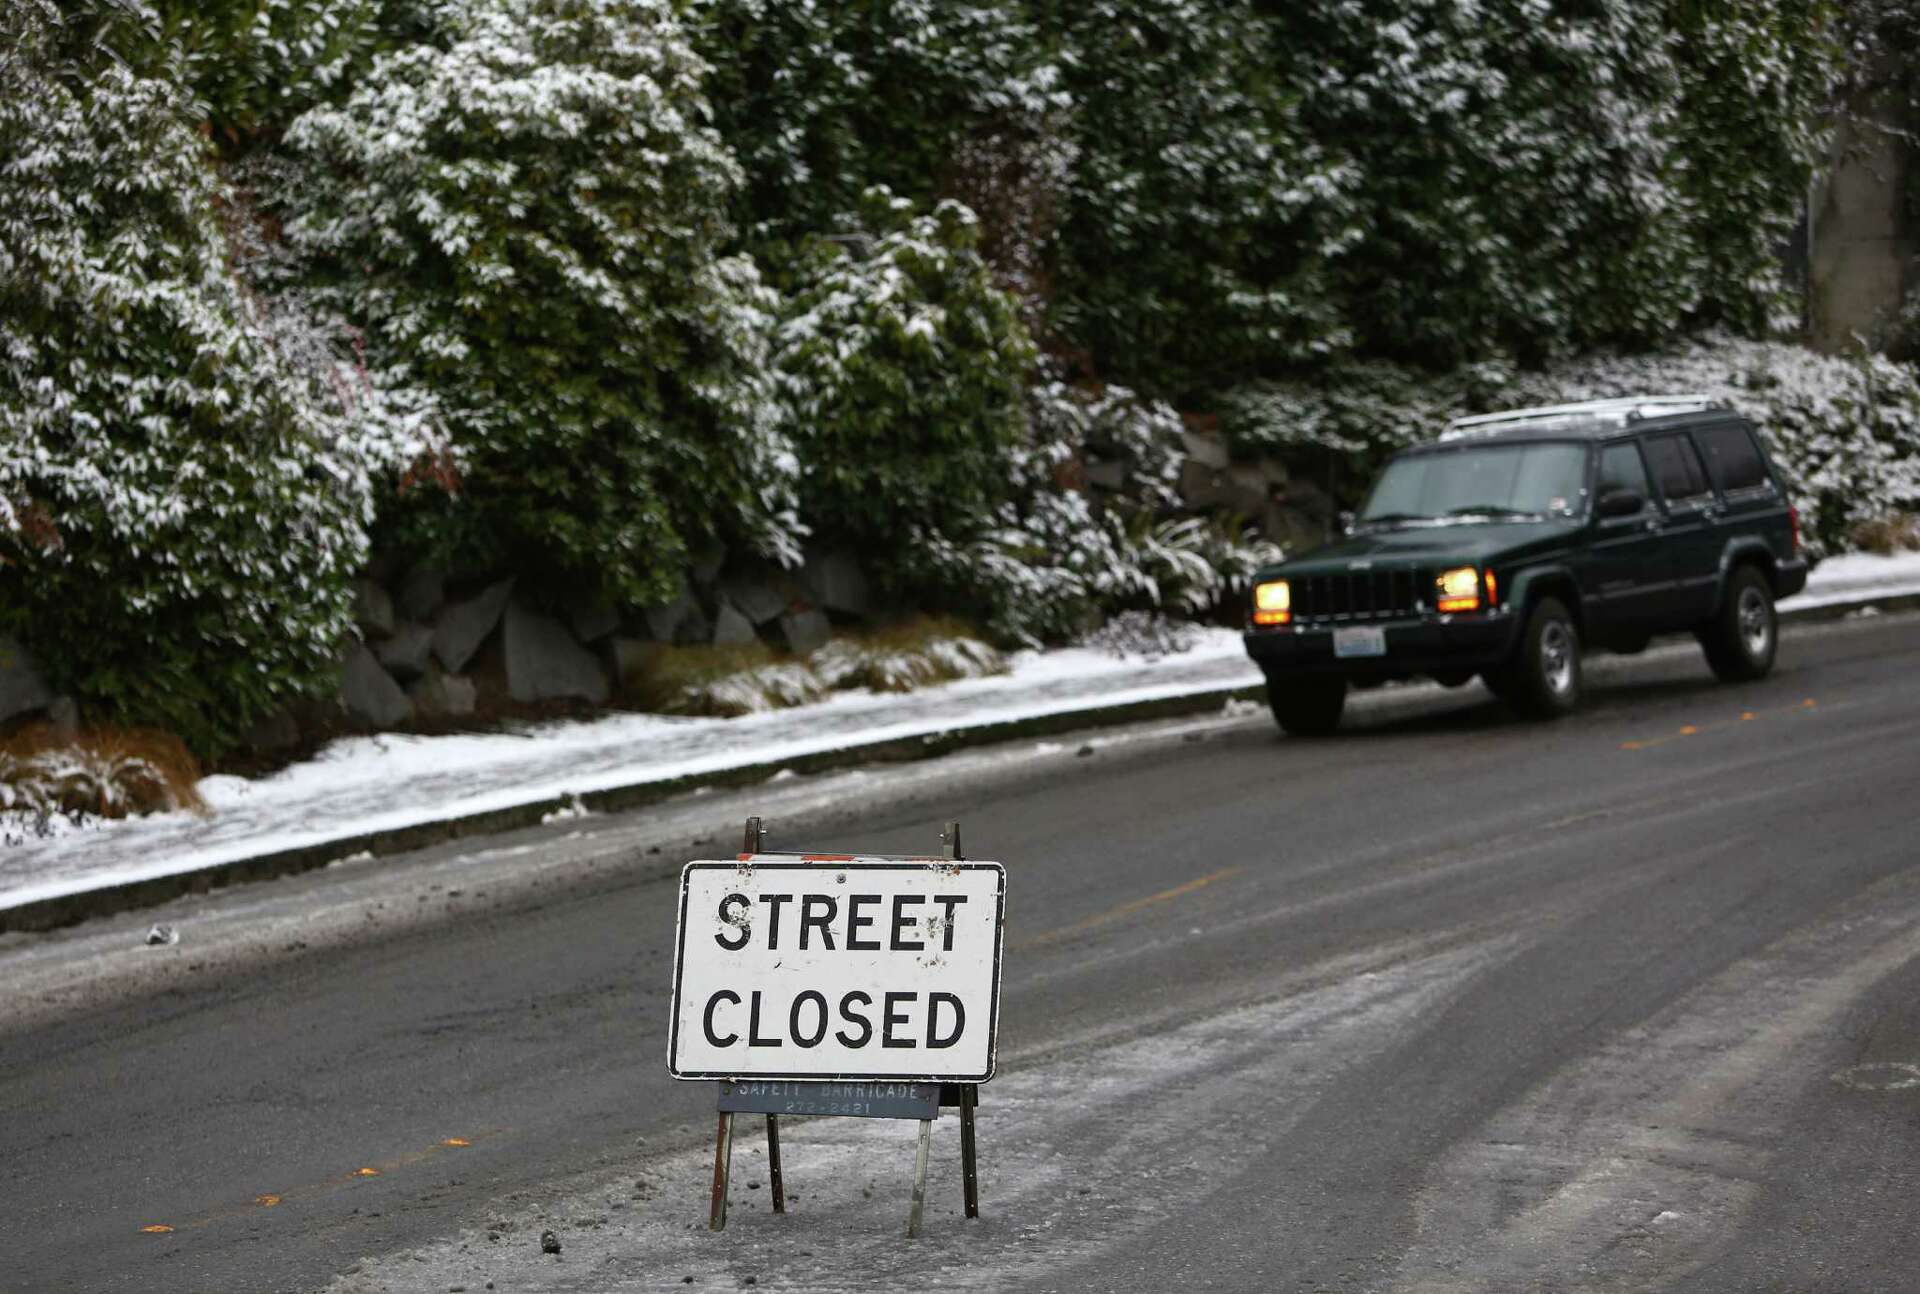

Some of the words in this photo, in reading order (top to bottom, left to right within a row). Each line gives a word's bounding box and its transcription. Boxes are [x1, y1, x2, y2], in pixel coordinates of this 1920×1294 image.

[714, 893, 969, 951] STREET
[703, 989, 966, 1049] CLOSED
[820, 1083, 919, 1099] BARRICADE
